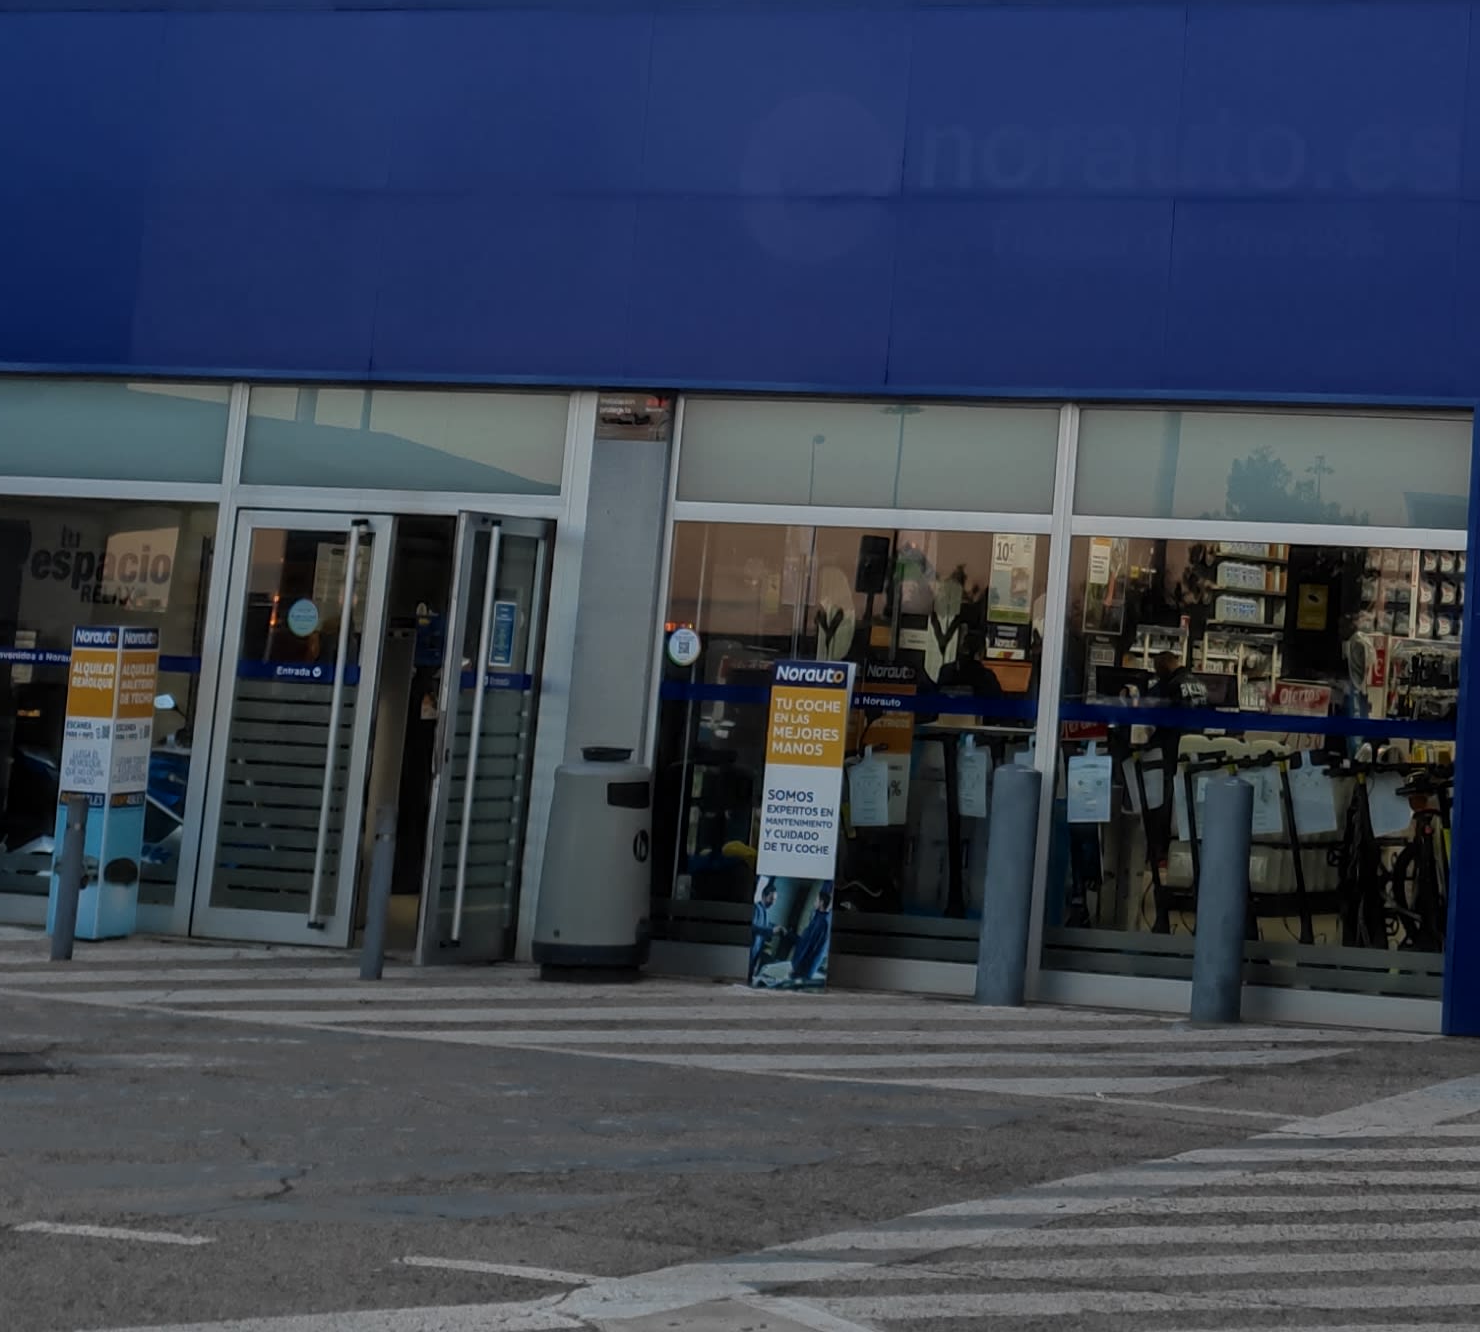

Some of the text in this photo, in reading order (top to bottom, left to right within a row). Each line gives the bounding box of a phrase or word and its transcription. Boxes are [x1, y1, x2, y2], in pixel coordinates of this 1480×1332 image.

[31, 544, 170, 590] espacio
[75, 629, 117, 644] Norauto
[124, 631, 158, 645] Norauto
[45, 652, 71, 663] Norau
[73, 661, 114, 676] ALQUILER
[276, 666, 311, 677] Entrada
[776, 666, 845, 683] Norauto
[867, 665, 916, 679] Norauto
[775, 697, 841, 713] TU COCHE
[863, 696, 901, 707] Norauto
[774, 712, 809, 724] EN LAS
[773, 726, 840, 741] MEJORES
[772, 742, 824, 756] MANOS
[768, 789, 814, 803] SOMOS
[767, 805, 834, 817] EXPERTOS EN
[766, 818, 833, 828] MANTENIMIENTO
[765, 828, 819, 841] Y CUIDADO
[763, 842, 830, 855] DE TU COCHE
